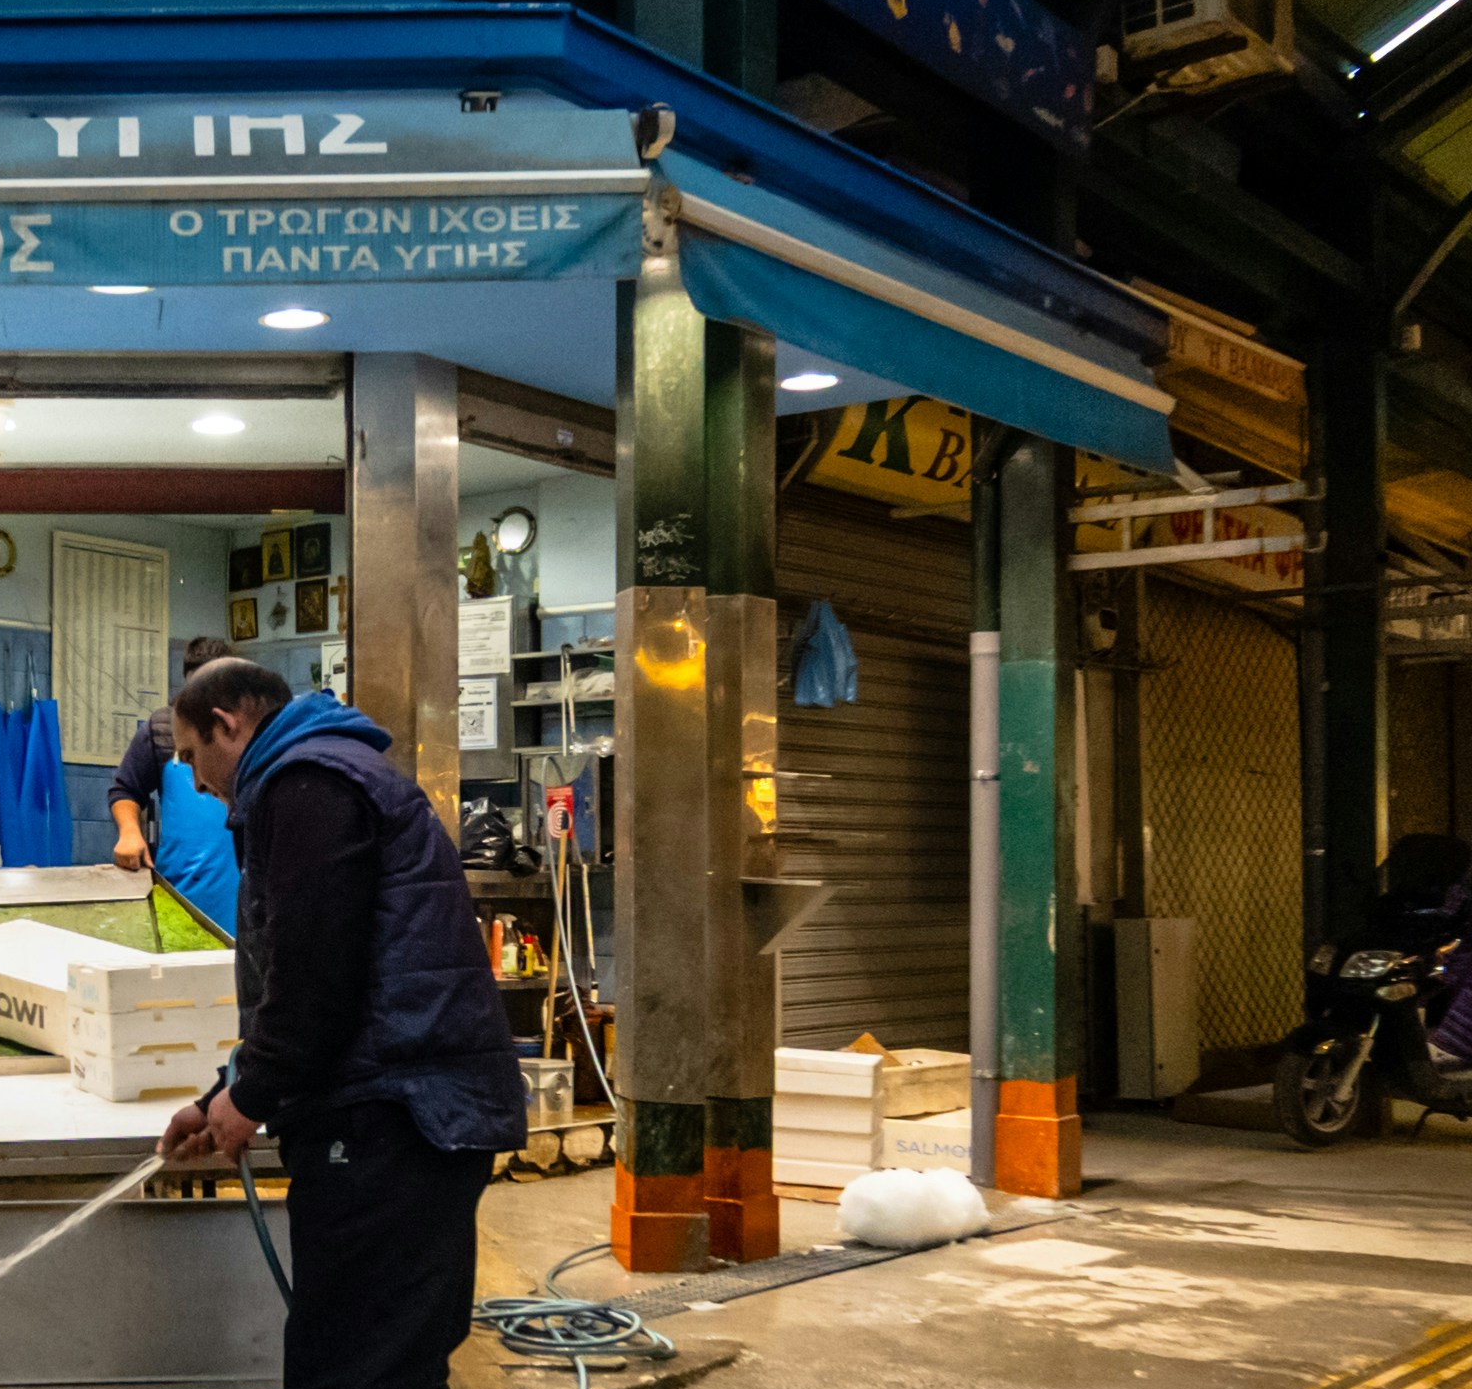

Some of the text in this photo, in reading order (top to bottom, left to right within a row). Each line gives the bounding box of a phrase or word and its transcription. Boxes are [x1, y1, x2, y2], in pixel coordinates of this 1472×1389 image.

[169, 204, 581, 237] Ο ΤΡΩΓΩΝ ΙΧΘΕΙΣ
[222, 240, 528, 273] ΠΑΝΤΑ ΥΓΙΗΣ
[896, 1139, 973, 1159] SALMO
